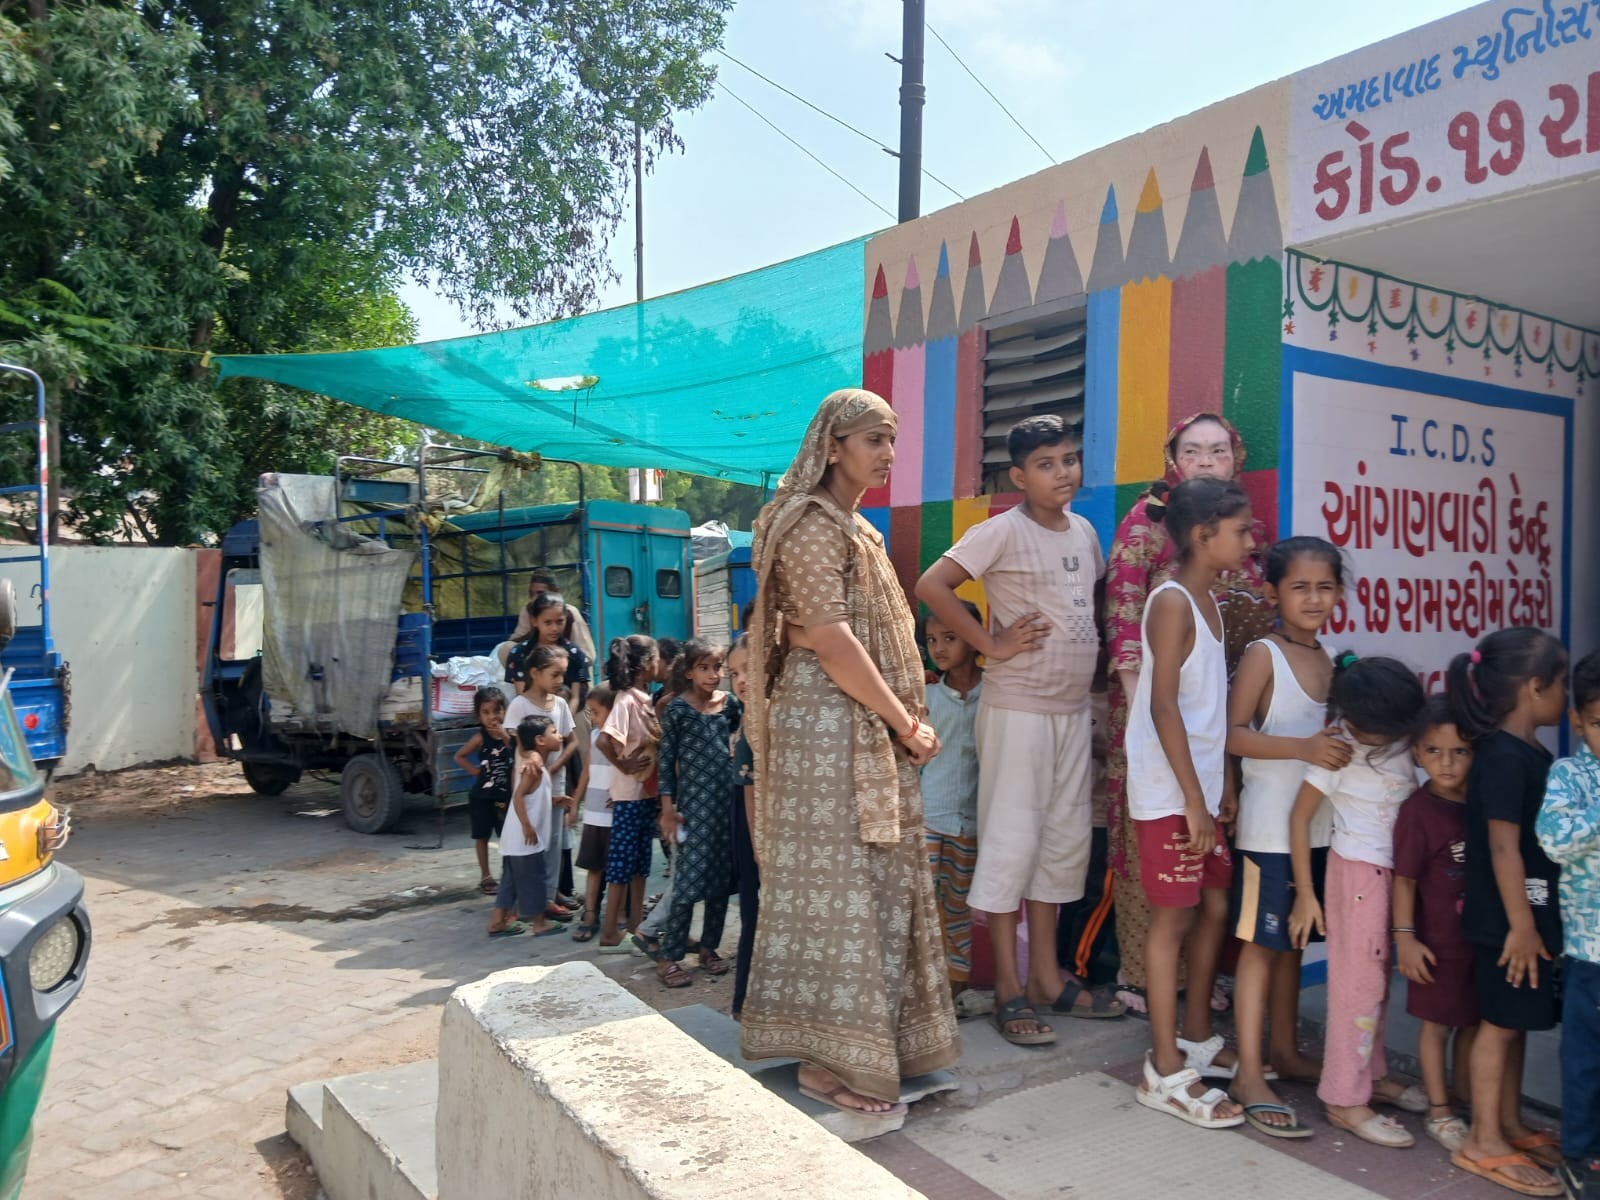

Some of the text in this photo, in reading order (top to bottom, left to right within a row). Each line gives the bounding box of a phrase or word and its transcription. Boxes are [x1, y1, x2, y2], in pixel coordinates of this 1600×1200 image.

[1312, 0, 1600, 120] અમદાવાદ મ્યુનિસિ
[1447, 99, 1525, 184] ૧૭
[1539, 70, 1600, 158] રા
[1390, 414, 1496, 467] I.C.D.S
[1321, 460, 1497, 557] આંગણવાડી
[1062, 556, 1080, 572] U
